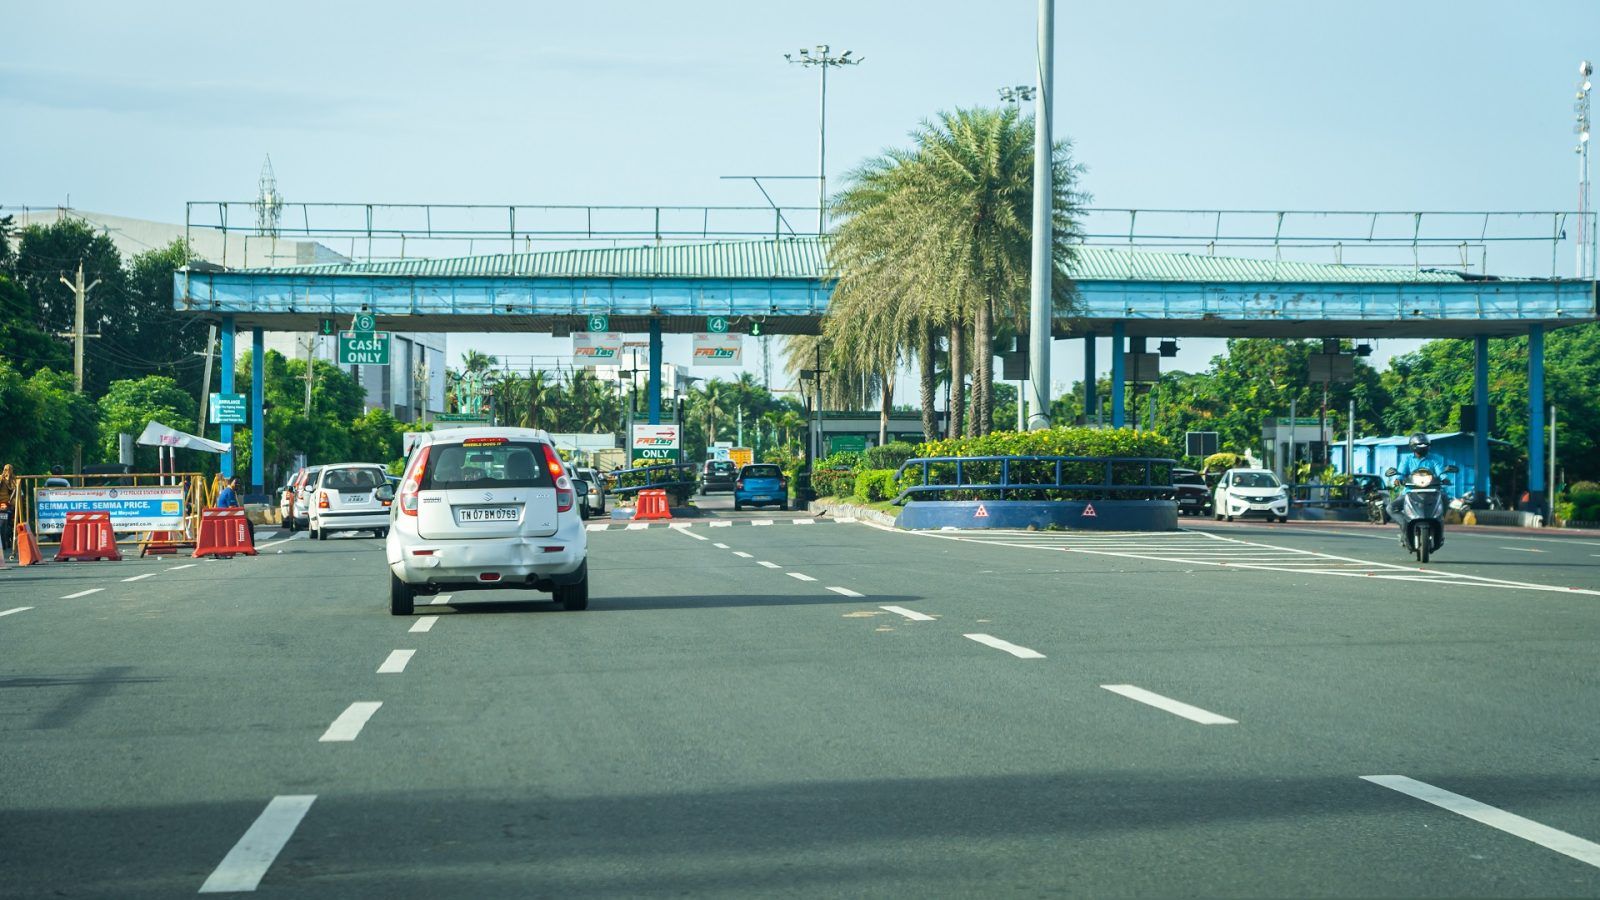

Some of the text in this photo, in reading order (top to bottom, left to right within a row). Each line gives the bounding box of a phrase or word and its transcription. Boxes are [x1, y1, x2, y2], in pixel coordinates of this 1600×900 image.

[361, 317, 369, 328] 6
[594, 318, 601, 330] 5
[713, 319, 722, 330] 4
[348, 340, 382, 350] CASH
[347, 352, 382, 362] ONLY
[642, 449, 669, 458] ONLY
[39, 501, 151, 510] SEMMA LIFE. SEMMA PRICE.
[461, 509, 516, 520] TN 07 BM 0769
